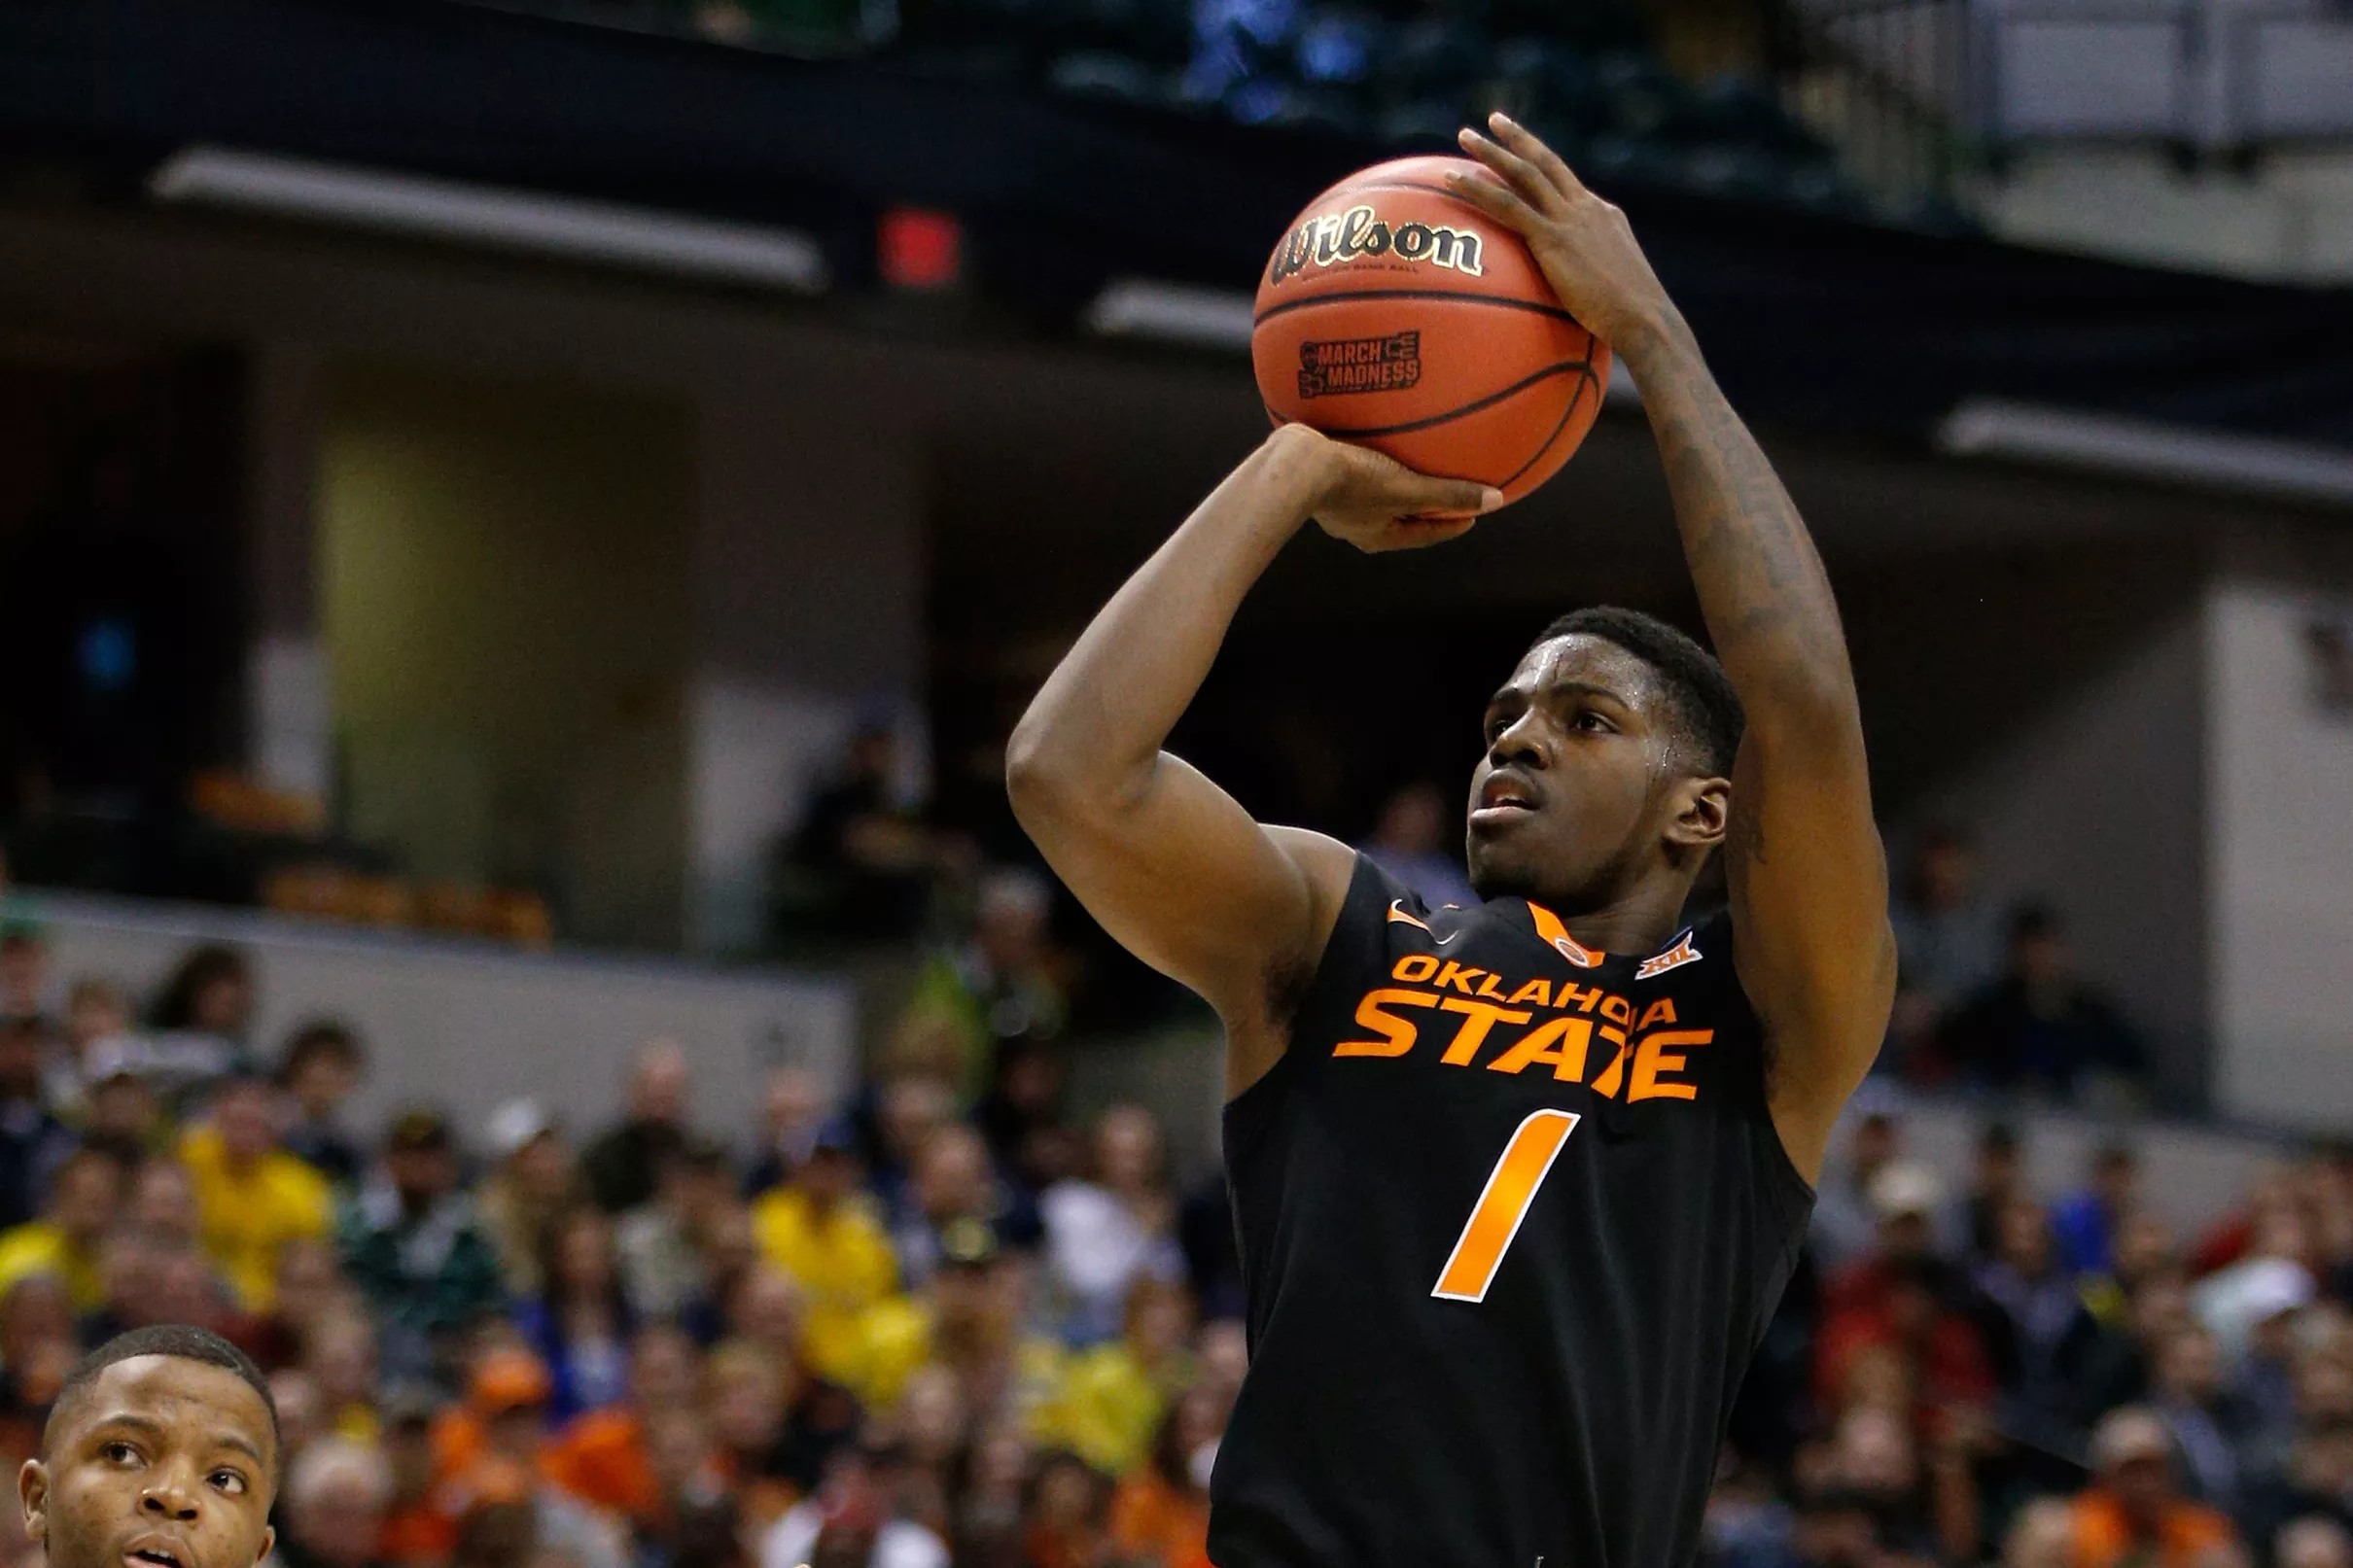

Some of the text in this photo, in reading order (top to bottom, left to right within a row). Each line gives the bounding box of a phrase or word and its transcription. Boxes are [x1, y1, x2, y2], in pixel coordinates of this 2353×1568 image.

[1271, 205, 1483, 285] Wilson
[1317, 340, 1381, 366] MARCH
[1327, 359, 1418, 388] MADNESS
[1391, 955, 1678, 1032] OKLAHOA
[1332, 989, 1714, 1104] STATE
[1430, 1108, 1581, 1303] 1
